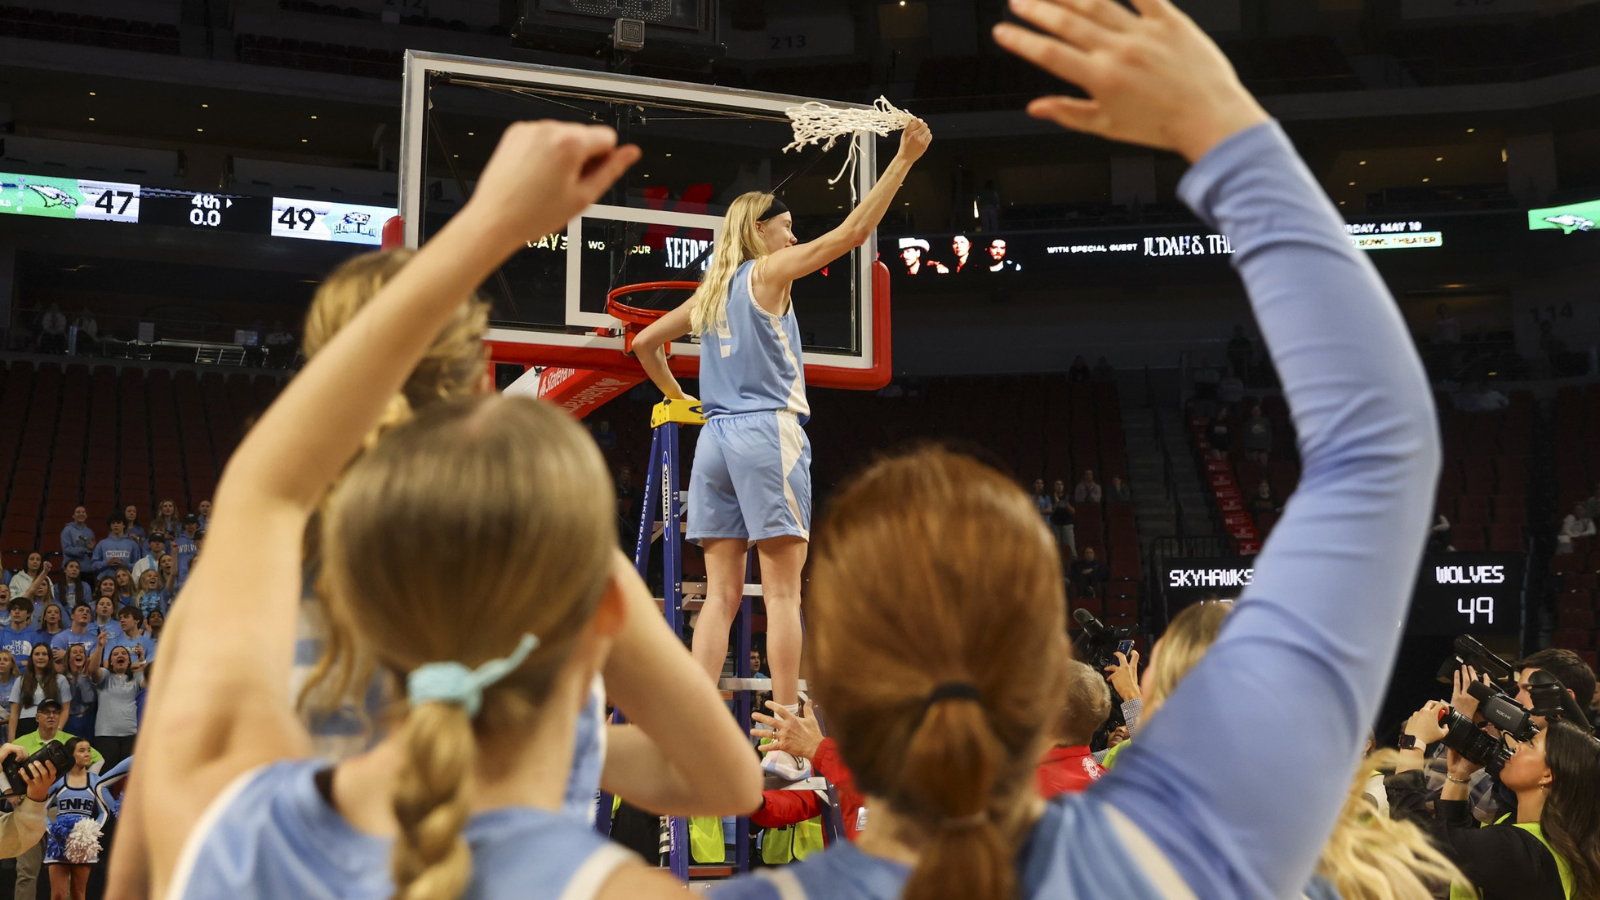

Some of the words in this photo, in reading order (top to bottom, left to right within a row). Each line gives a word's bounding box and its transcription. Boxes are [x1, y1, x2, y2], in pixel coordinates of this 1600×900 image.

[770, 35, 806, 49] 213
[94, 189, 134, 214] 47
[191, 194, 221, 210] 4th
[189, 208, 221, 226] 0.0
[277, 206, 316, 231] 49
[1380, 221, 1407, 233] MAY
[1046, 246, 1070, 254] WITH
[1070, 244, 1108, 254] SPECIAL
[1109, 243, 1138, 252] GUEST
[1143, 235, 1191, 257] JUDAH
[1191, 234, 1205, 255] &
[1359, 238, 1388, 246] BOWL
[636, 484, 651, 553] BASKETBALL
[1169, 569, 1254, 586] SKYHAWKS
[1435, 565, 1505, 584] WOLVES
[1457, 596, 1494, 624] 49
[58, 797, 95, 811] ENHS
